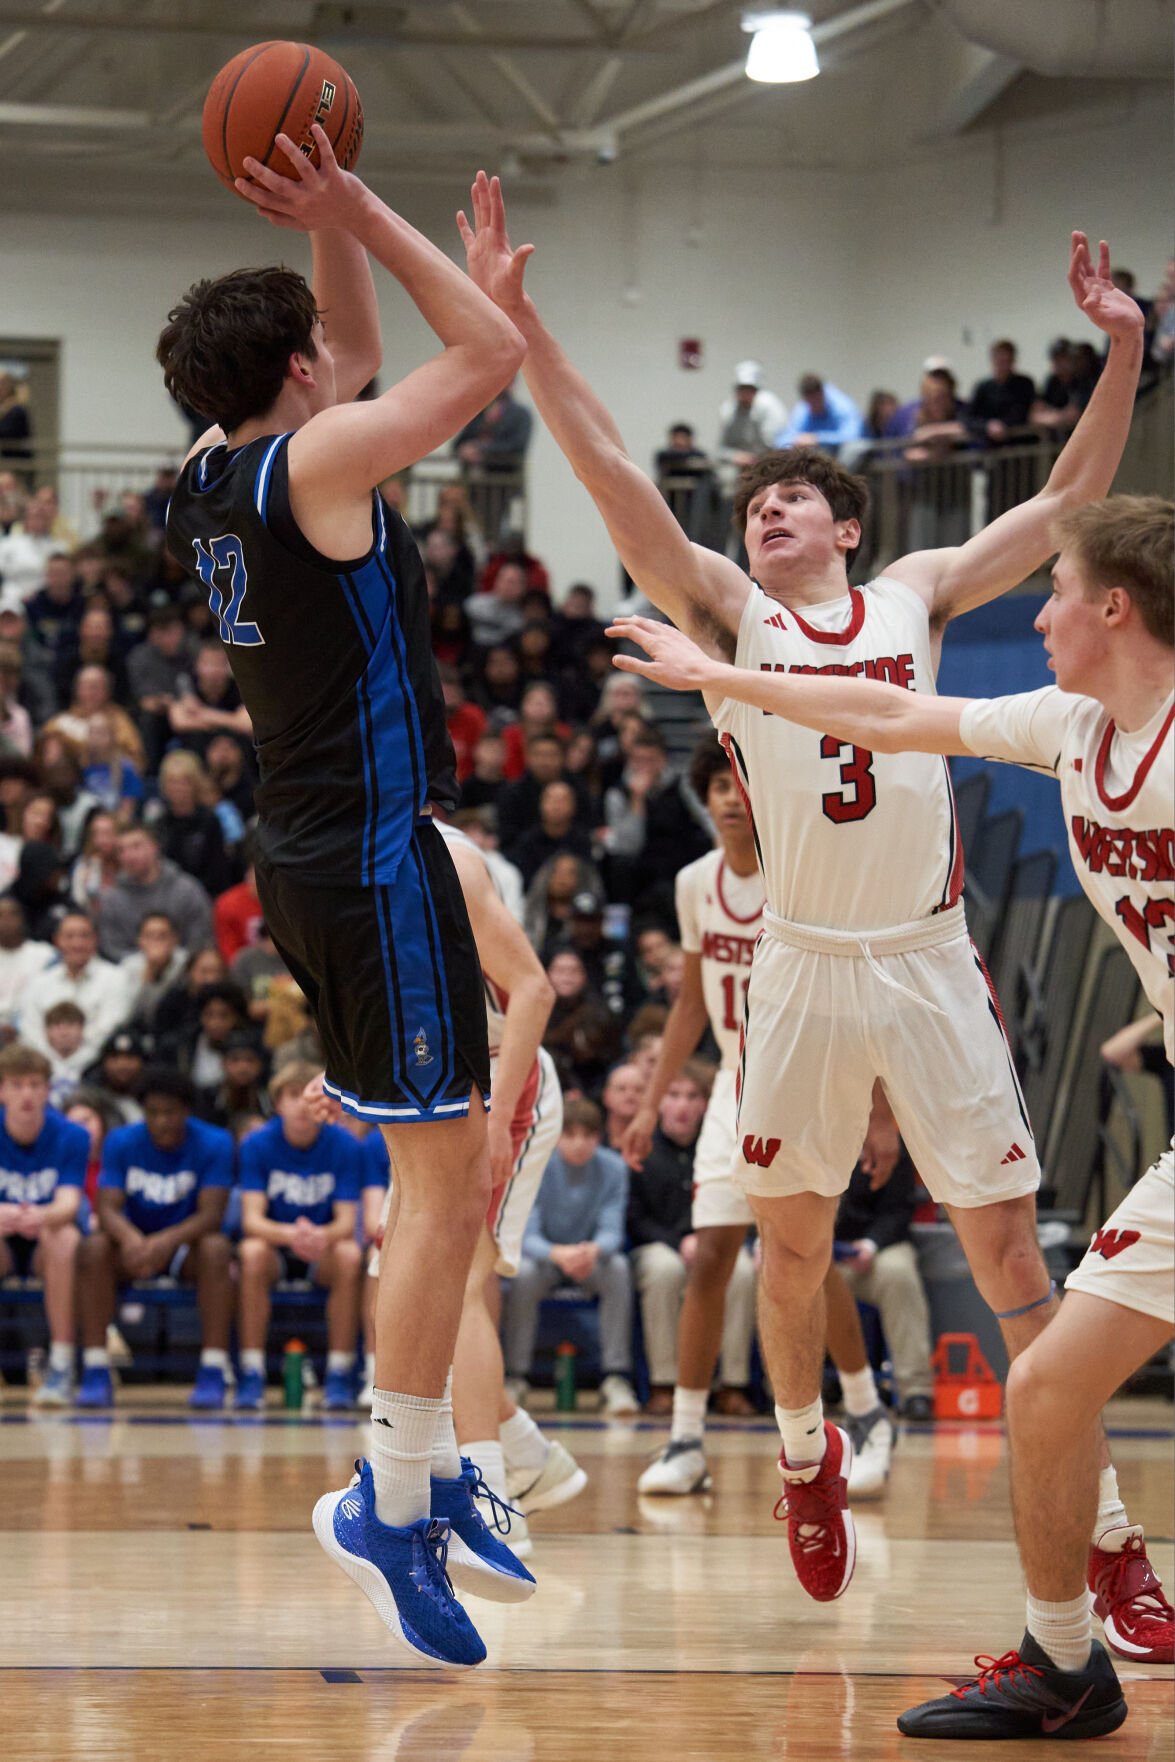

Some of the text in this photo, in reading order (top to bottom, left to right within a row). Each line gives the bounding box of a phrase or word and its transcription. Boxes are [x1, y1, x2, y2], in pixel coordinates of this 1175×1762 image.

[192, 533, 266, 646] 12
[820, 734, 877, 824] 3
[743, 1135, 782, 1168] W
[1089, 1228, 1141, 1260] W
